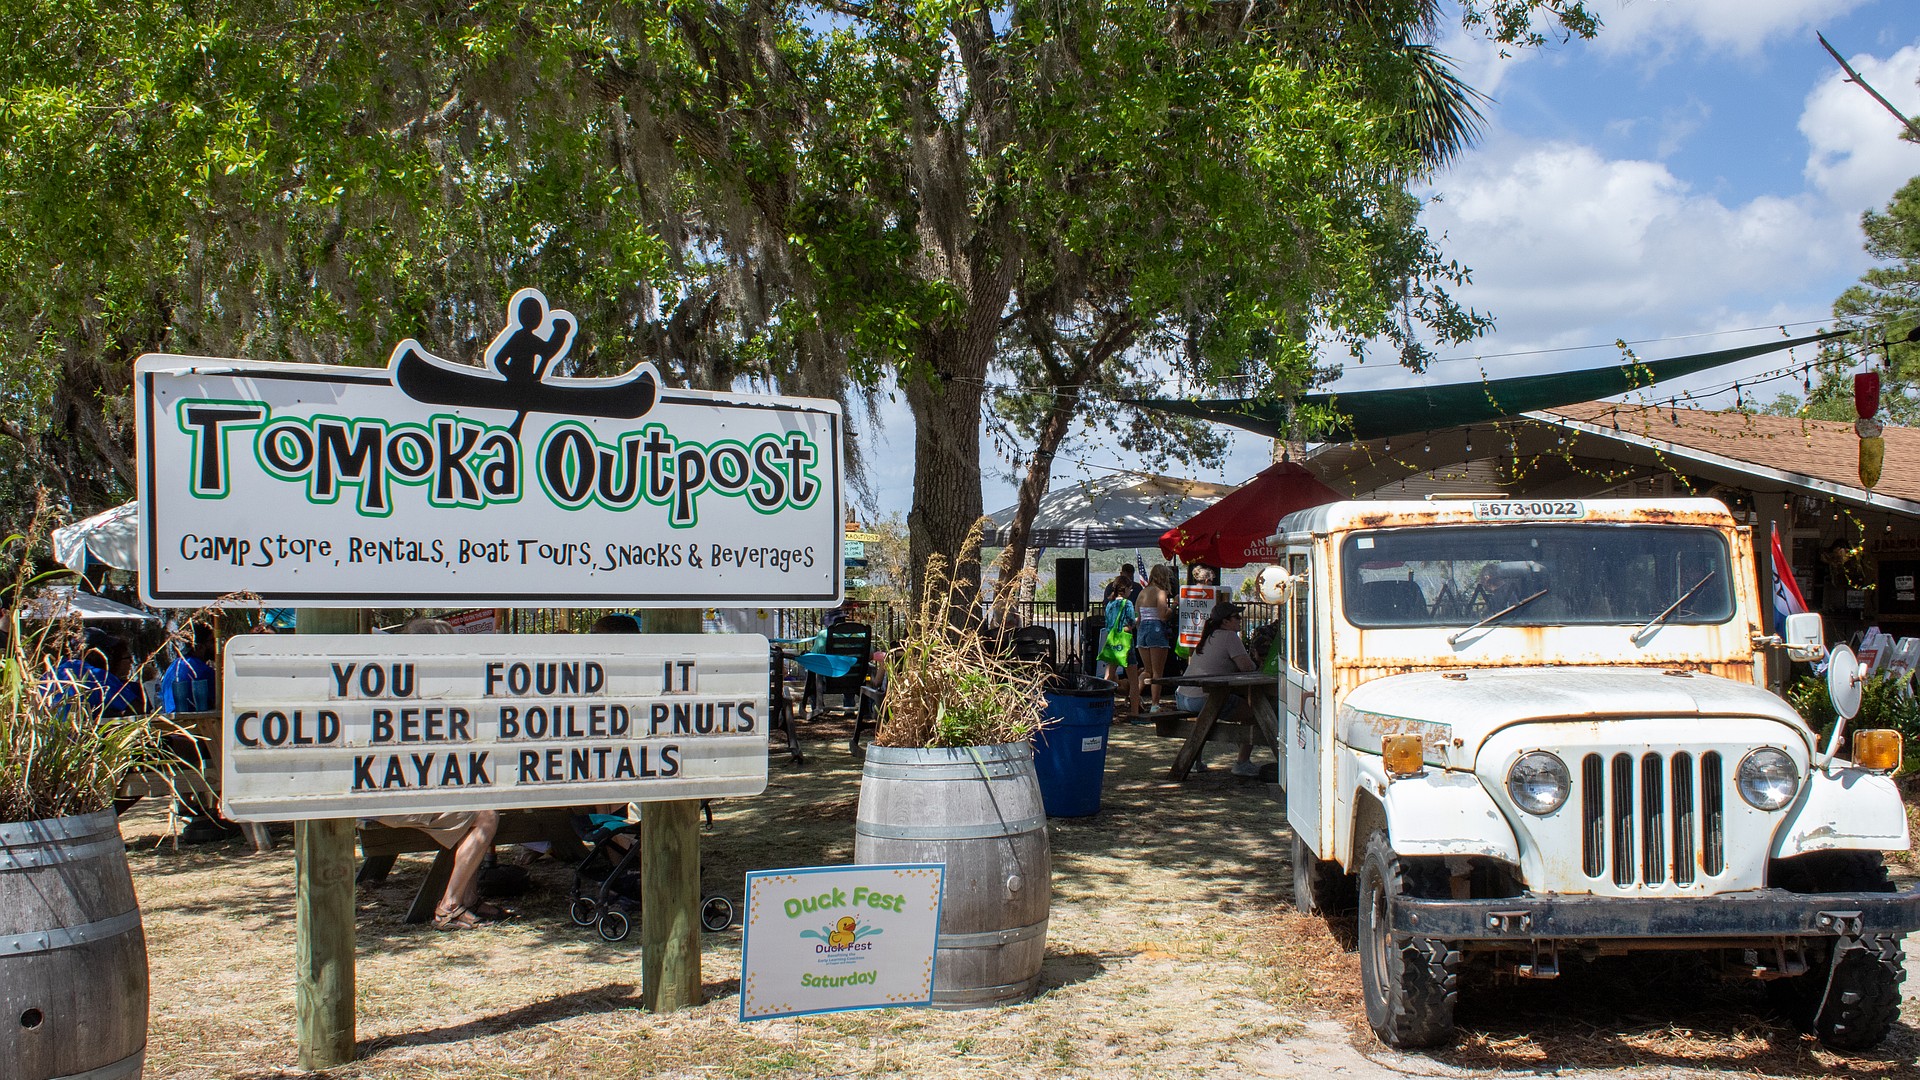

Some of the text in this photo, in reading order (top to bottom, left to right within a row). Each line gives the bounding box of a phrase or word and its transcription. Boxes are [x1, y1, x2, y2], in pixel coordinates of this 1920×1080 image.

[1490, 503, 1578, 515] 673-0022
[688, 543, 704, 569] &
[1243, 546, 1281, 557] ORCHA
[1186, 599, 1208, 608] RETURN
[1181, 611, 1198, 620] RENTAL
[331, 660, 696, 698] YOU FOUND IT
[234, 700, 756, 748] COLD BEER BOILED PNUTS
[354, 743, 681, 791] KAYAK RENTALS
[783, 886, 906, 919] Duck Fest
[815, 941, 873, 954] Duck Fest
[801, 970, 877, 988] Saturday
